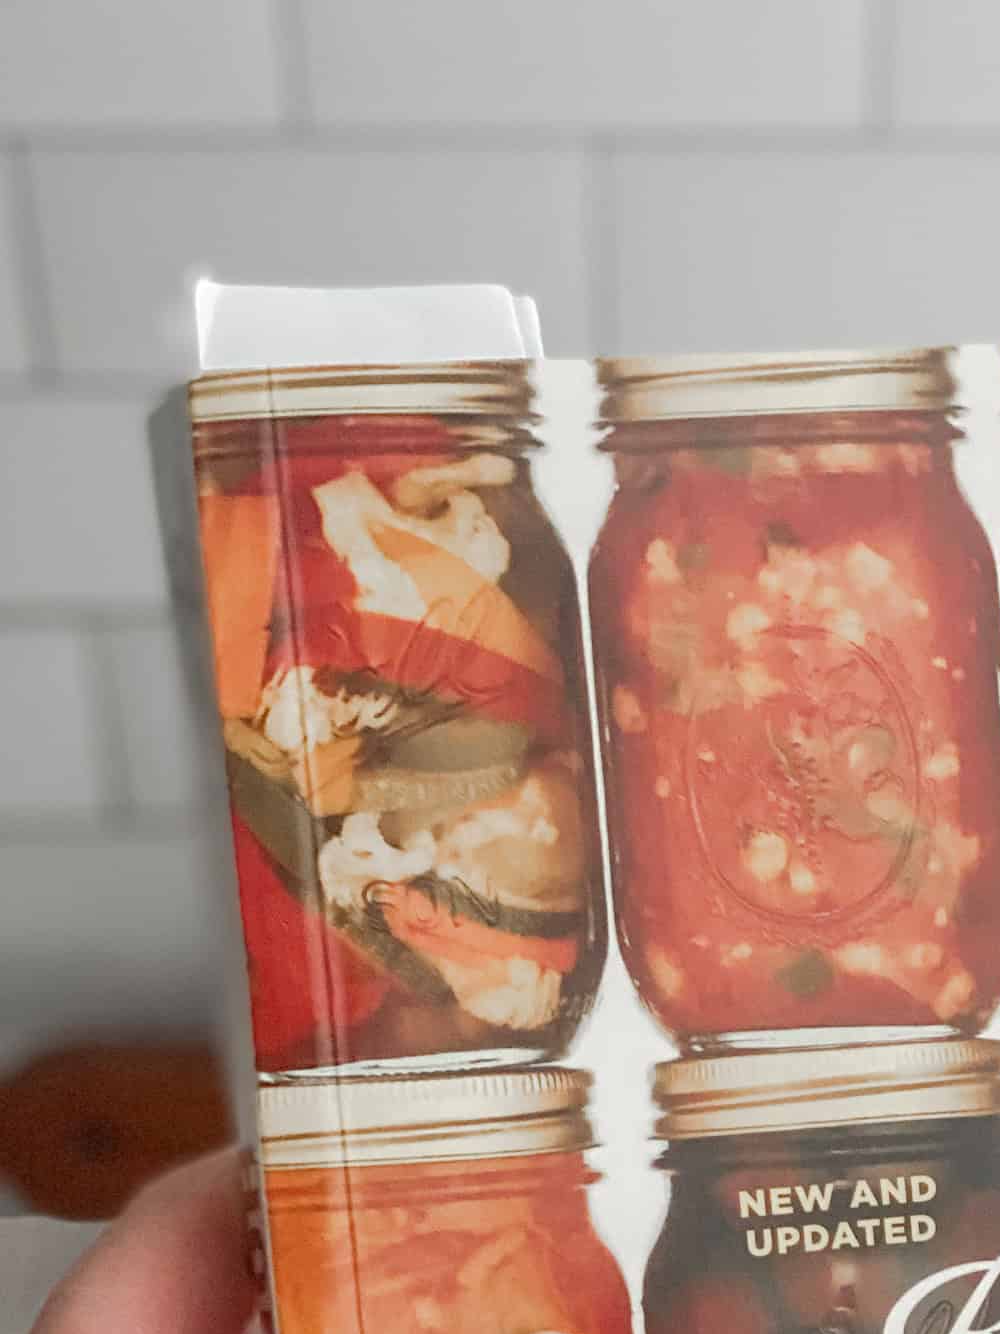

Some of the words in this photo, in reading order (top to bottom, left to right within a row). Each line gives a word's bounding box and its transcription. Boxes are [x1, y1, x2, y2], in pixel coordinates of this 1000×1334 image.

[738, 1183, 833, 1218] NEW
[849, 1175, 937, 1209] AND
[745, 1214, 937, 1256] UPDATED
